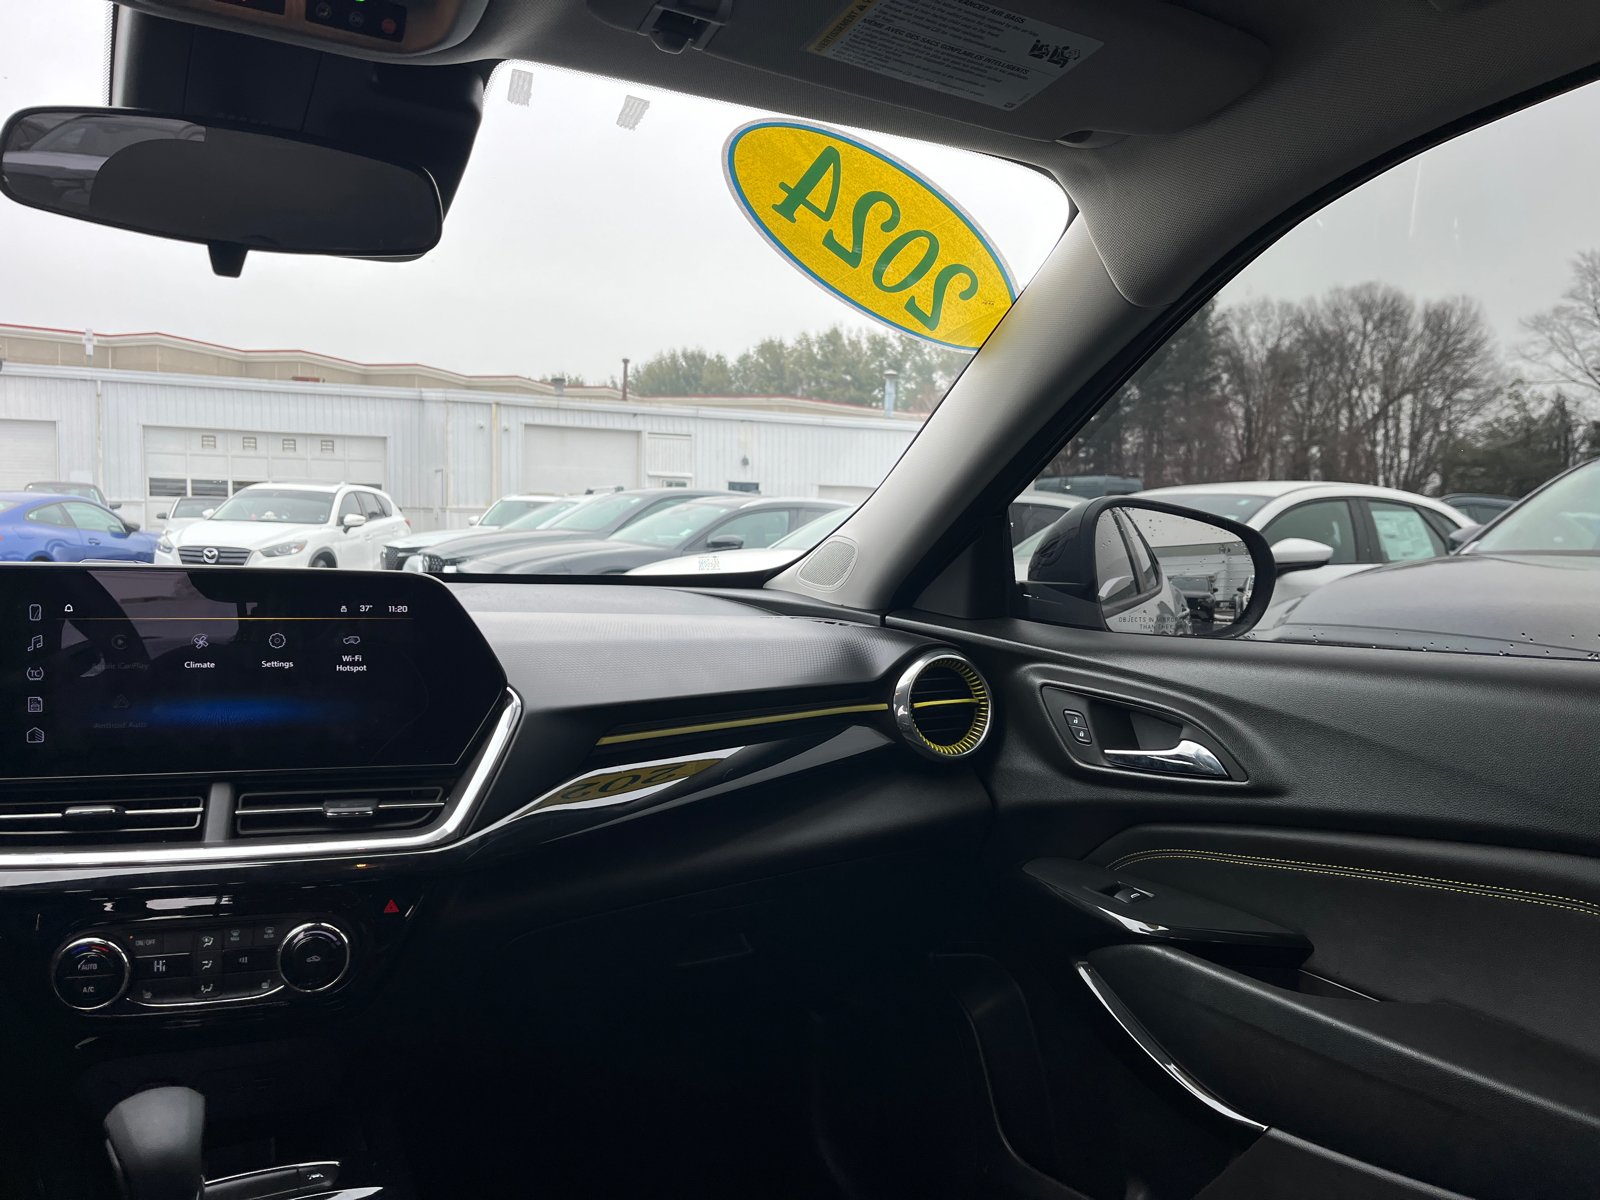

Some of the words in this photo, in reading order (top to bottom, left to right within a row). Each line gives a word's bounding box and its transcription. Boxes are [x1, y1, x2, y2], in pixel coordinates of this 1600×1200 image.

[1003, 13, 1027, 23] BAGS
[814, 11, 860, 53] AVERTISSEMENT
[884, 25, 906, 35] AVEC
[904, 32, 921, 40] DES
[920, 37, 941, 46] SACS
[939, 43, 985, 60] GONFLABLES
[982, 57, 1030, 74] INTELLIGENTS
[359, 604, 373, 613] 37°
[388, 605, 408, 613] 11:20
[341, 654, 362, 663] Wi-Fi
[184, 661, 215, 669] Climate
[261, 660, 294, 670] Settings
[336, 664, 367, 673] Hotspot
[81, 963, 98, 971] AUTO
[154, 959, 166, 972] Hi
[82, 986, 95, 994] A/C
